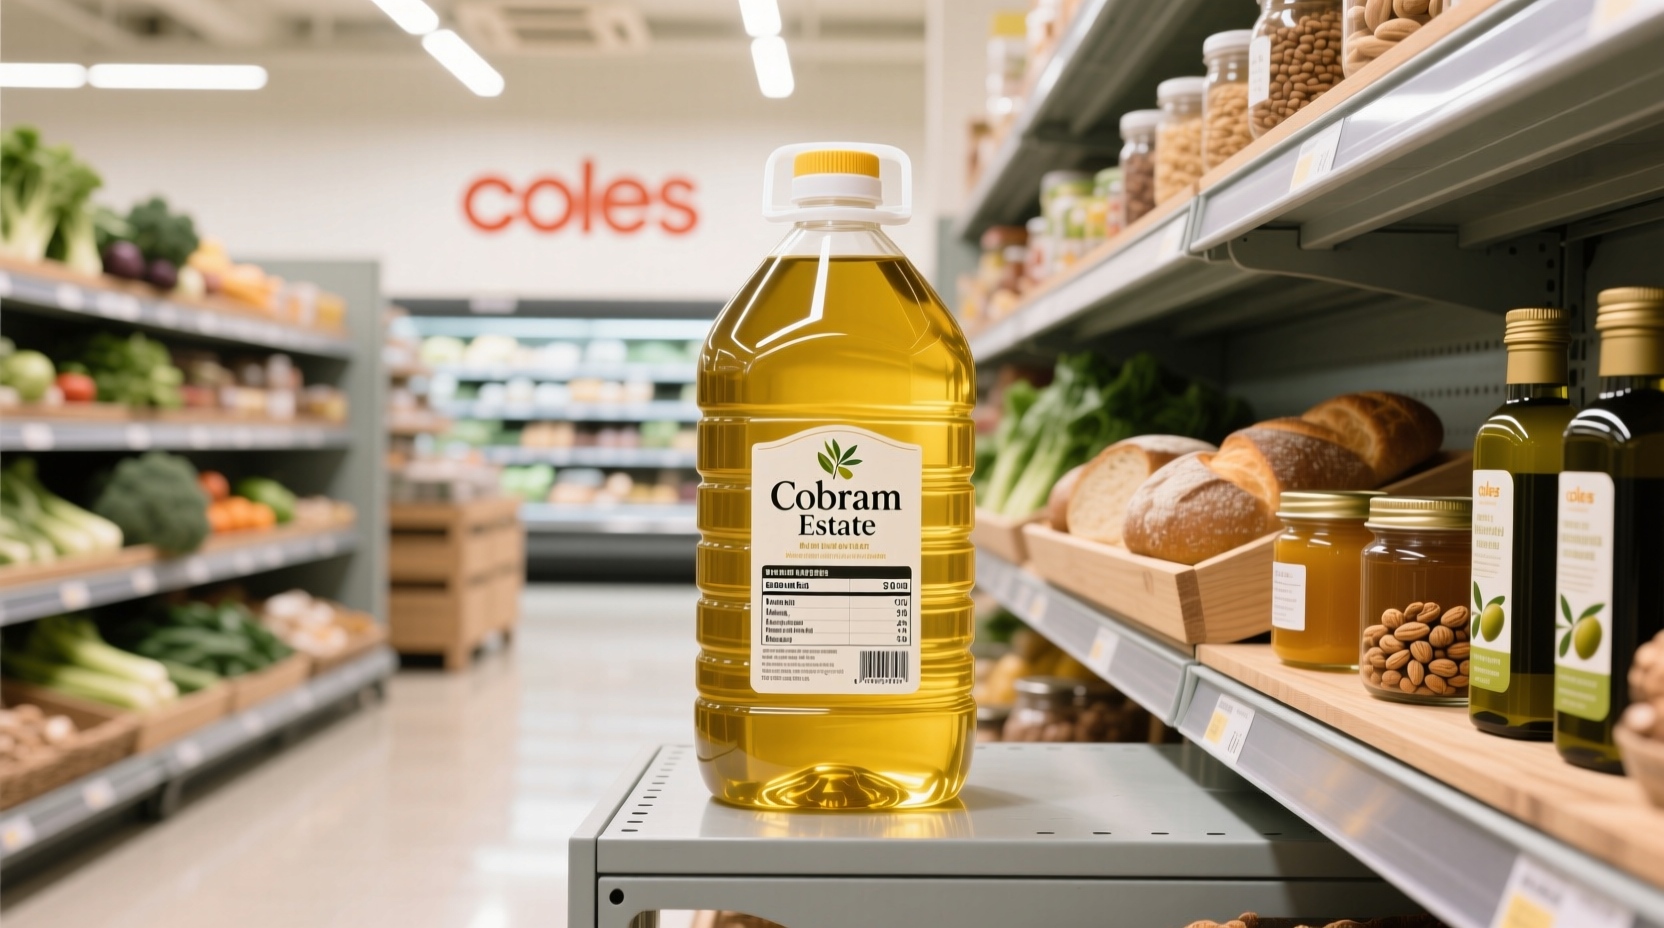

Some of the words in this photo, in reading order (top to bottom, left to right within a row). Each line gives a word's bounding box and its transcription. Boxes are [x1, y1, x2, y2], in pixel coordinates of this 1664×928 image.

[462, 159, 699, 236] coles
[771, 479, 901, 511] Cobram
[798, 514, 876, 537] Estate
